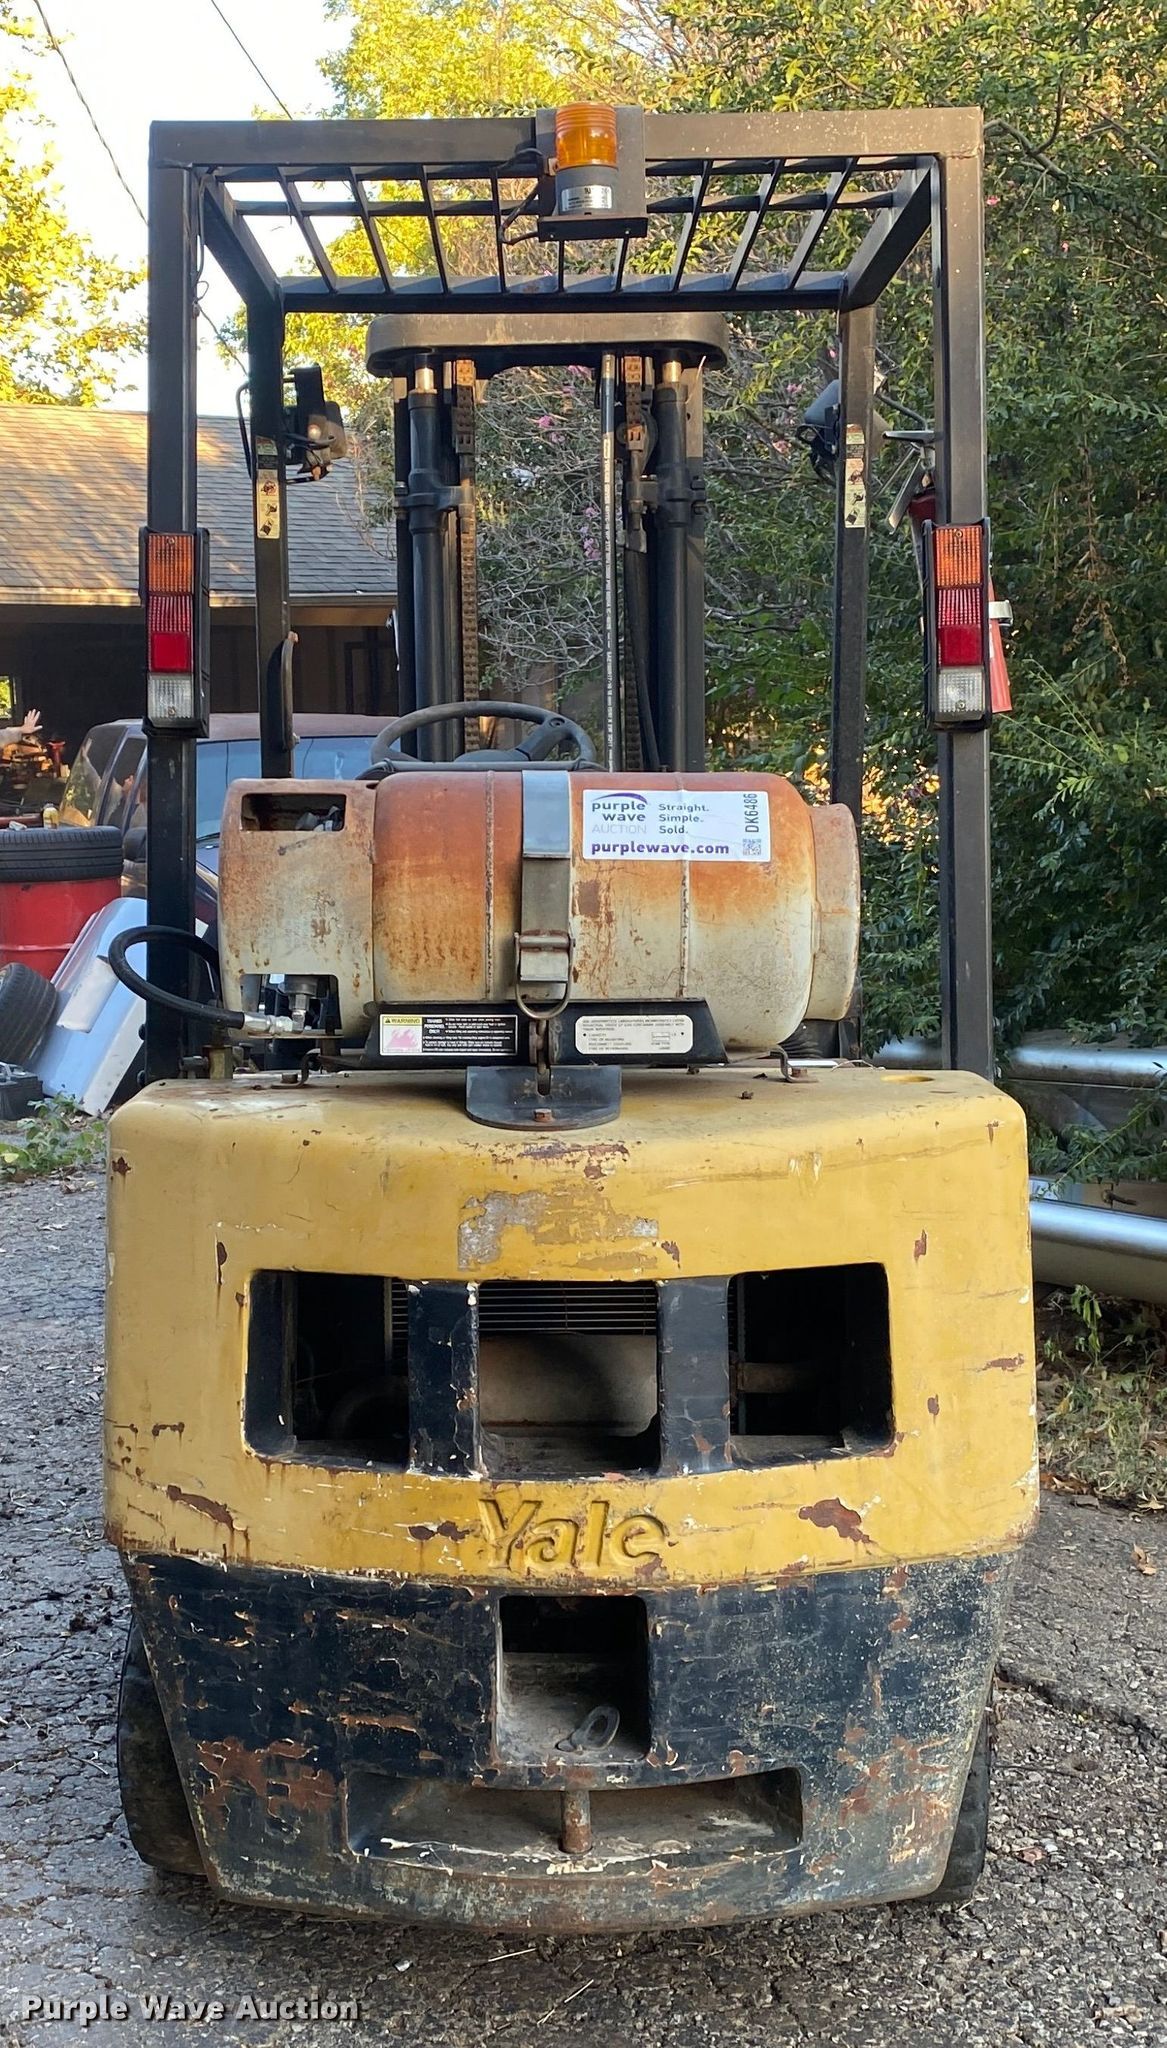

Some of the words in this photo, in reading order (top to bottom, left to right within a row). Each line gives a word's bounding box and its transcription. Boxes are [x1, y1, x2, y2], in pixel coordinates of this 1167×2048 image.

[591, 801, 646, 813] purple
[658, 803, 710, 813] Straight.
[602, 813, 646, 822] wave
[658, 813, 704, 823] Simple.
[742, 793, 760, 833] DK6486
[591, 824, 647, 834] AUCTION
[658, 825, 689, 834] Sold.
[591, 841, 730, 856] purplewave.com
[477, 1498, 669, 1568] Yale
